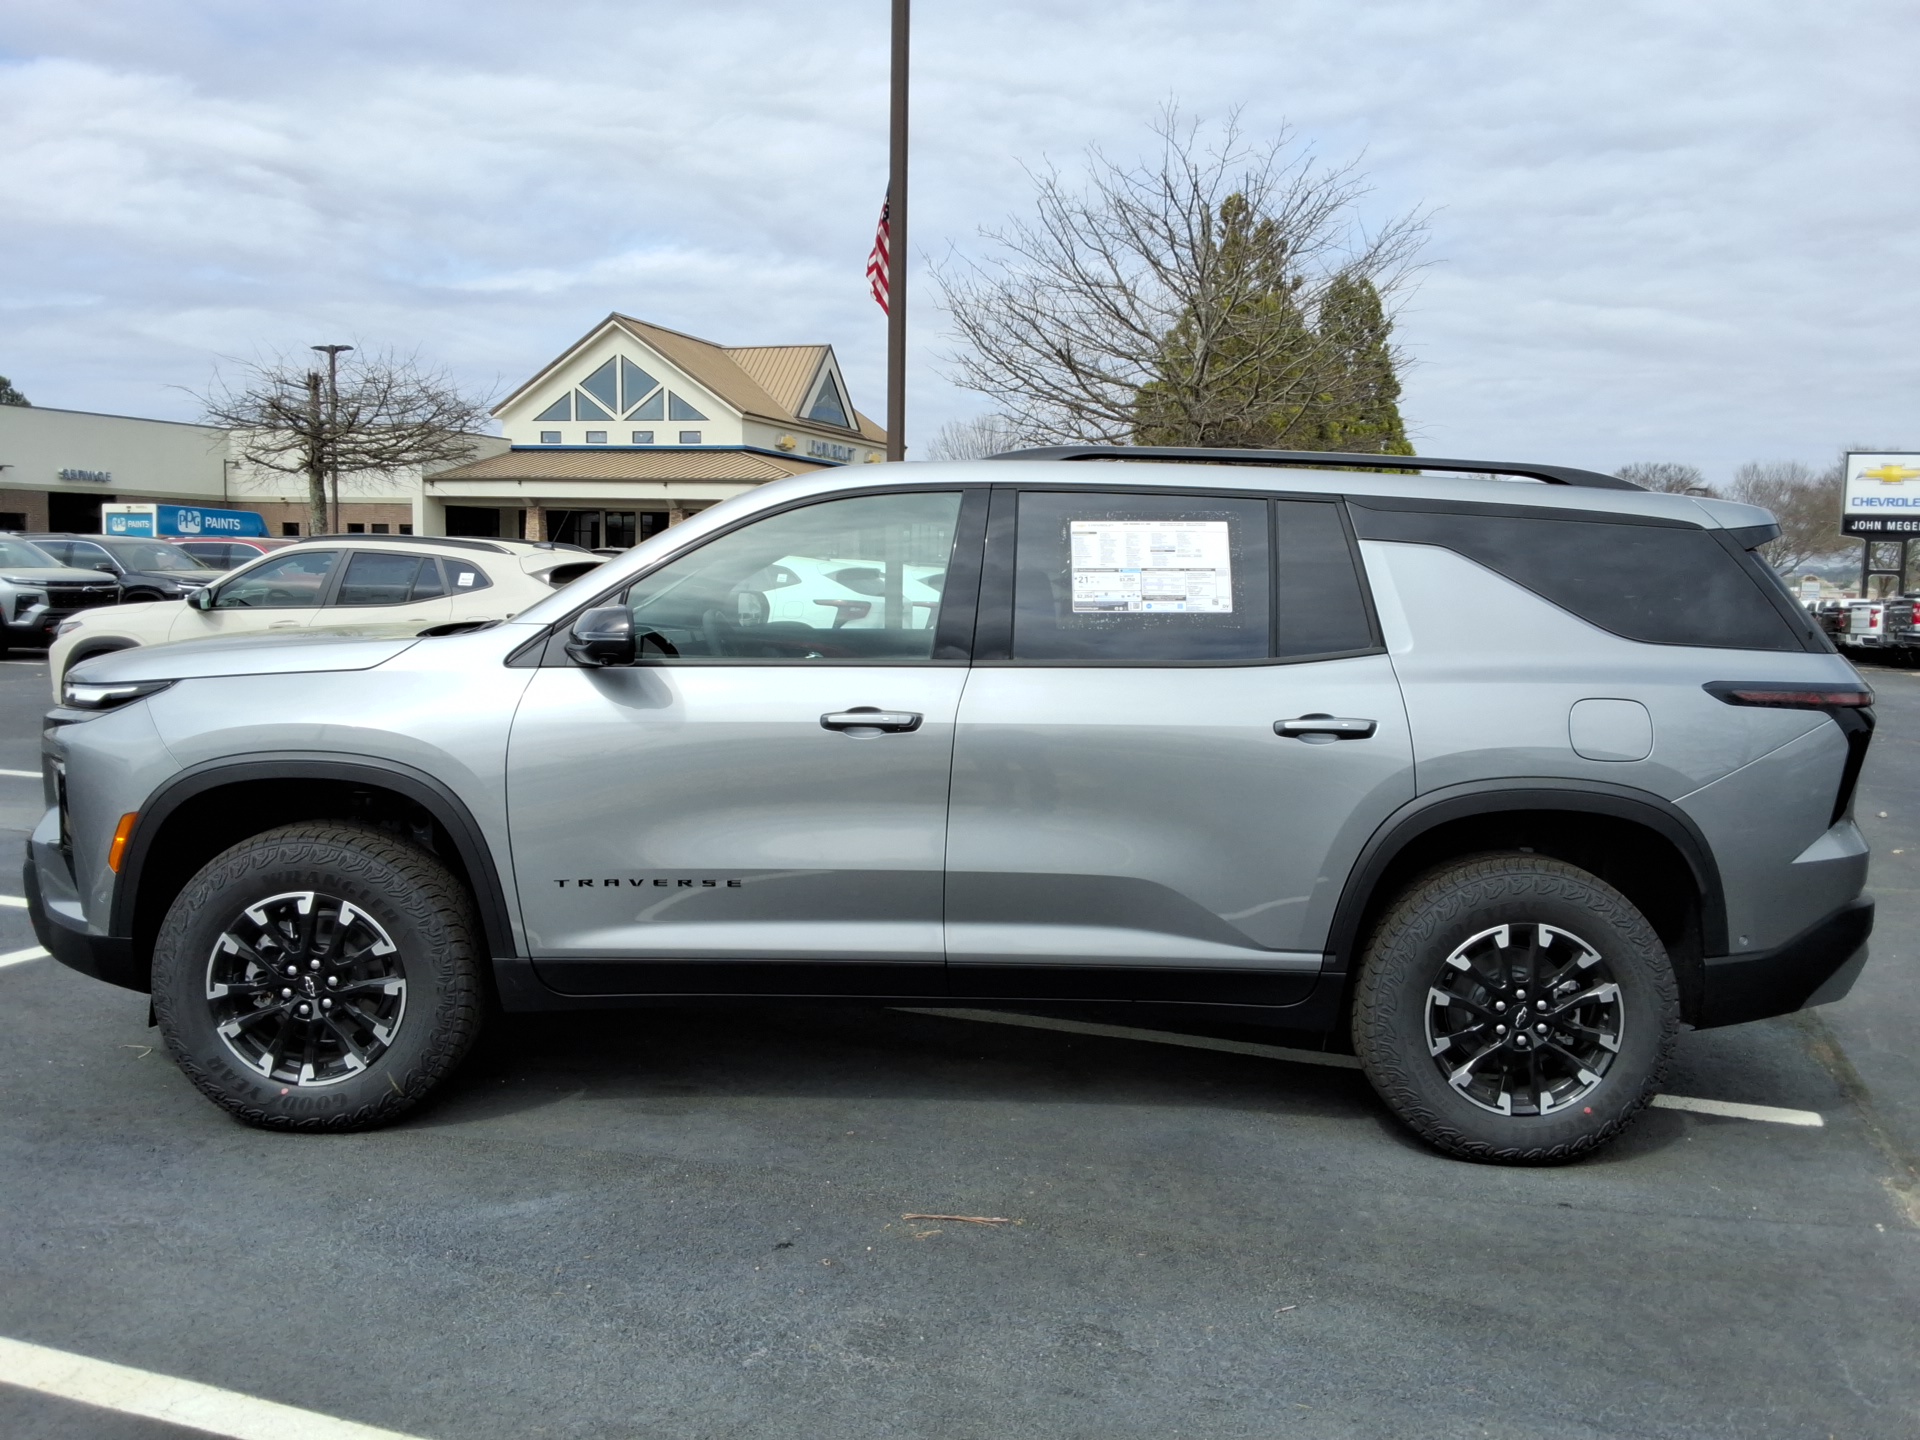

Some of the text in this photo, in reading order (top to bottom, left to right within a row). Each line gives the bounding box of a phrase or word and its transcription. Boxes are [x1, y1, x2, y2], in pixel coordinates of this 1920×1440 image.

[57, 468, 112, 482] SERVICE
[127, 520, 150, 528] PAINTS
[178, 511, 201, 532] PPG
[205, 517, 241, 531] PAINTS
[1851, 520, 1882, 531] JOHN
[1078, 576, 1089, 584] 21
[553, 878, 742, 888] TRAVERSE
[262, 870, 401, 923] WRANGLER
